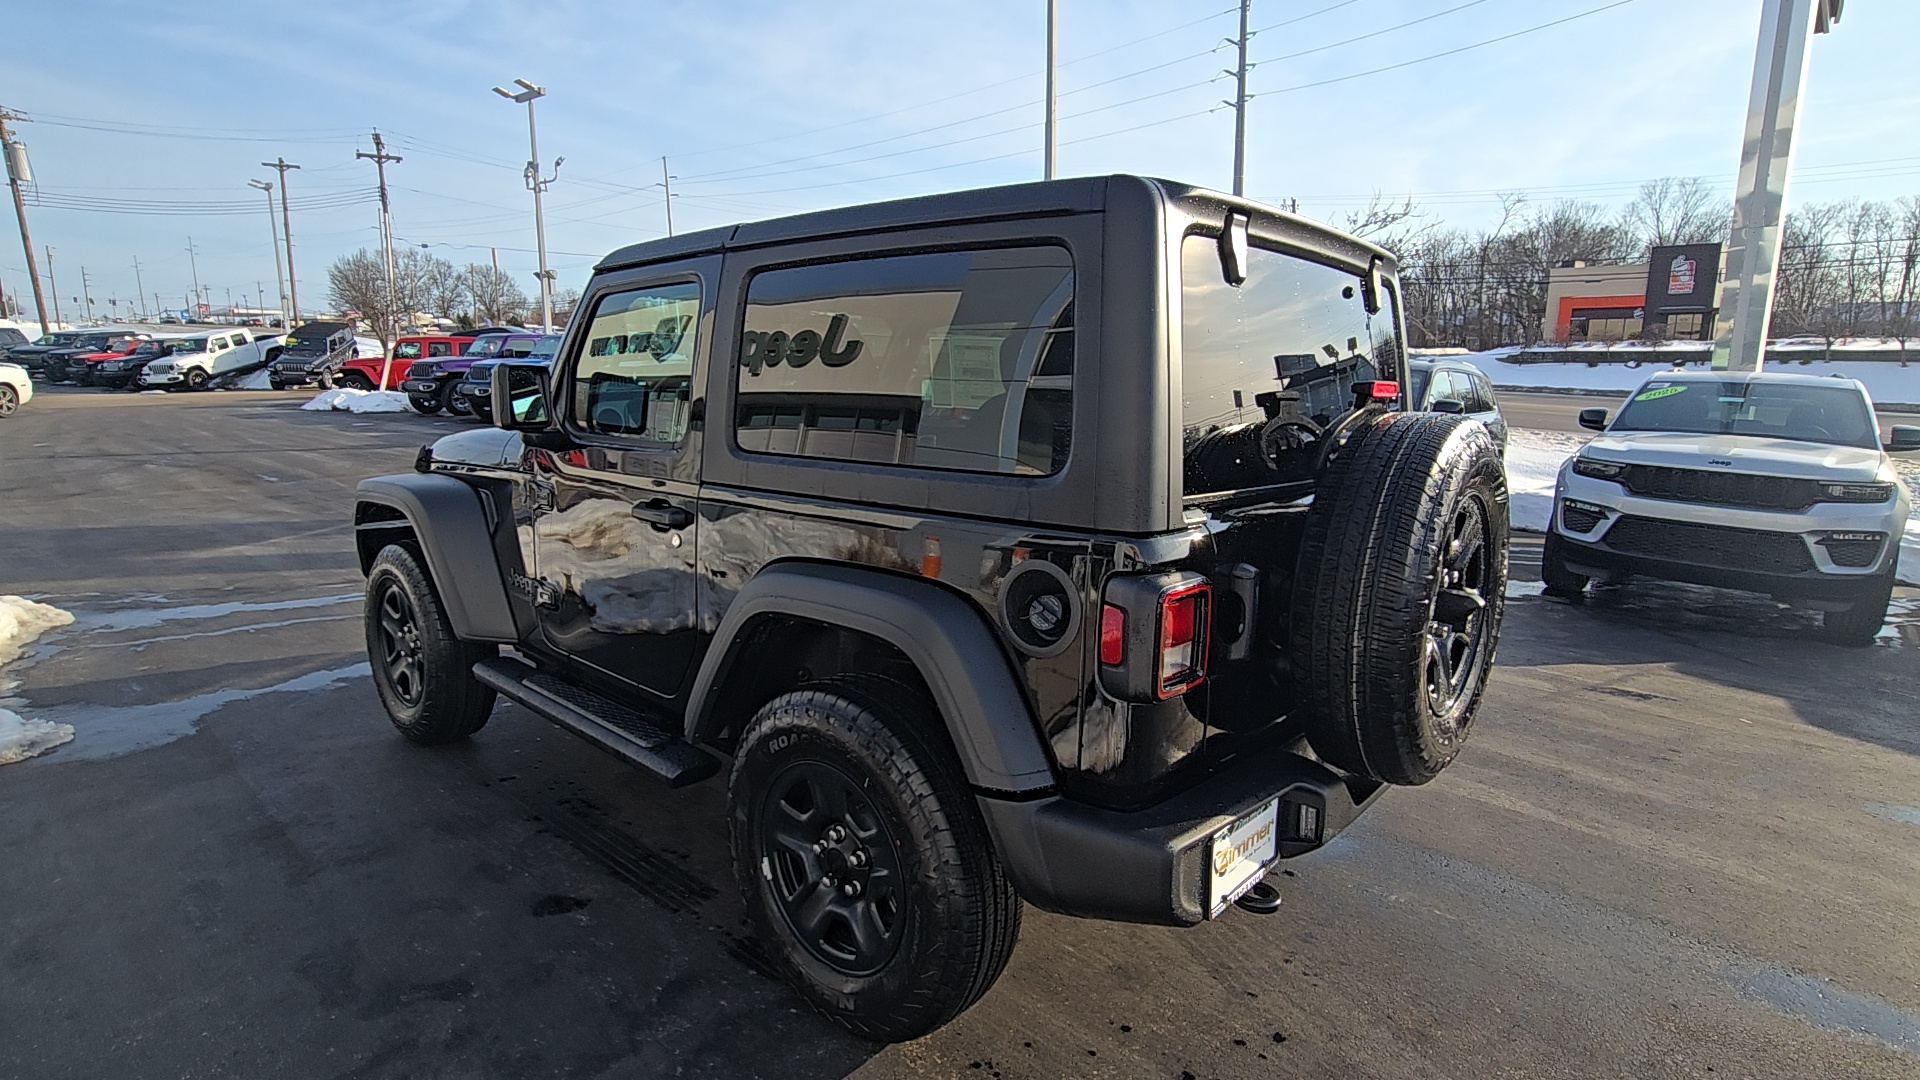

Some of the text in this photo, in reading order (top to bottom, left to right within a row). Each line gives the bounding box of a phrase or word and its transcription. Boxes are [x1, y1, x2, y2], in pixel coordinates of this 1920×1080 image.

[1708, 459, 1732, 467] Jeep
[509, 567, 532, 596] Jeep
[1215, 818, 1275, 873] Zimmer
